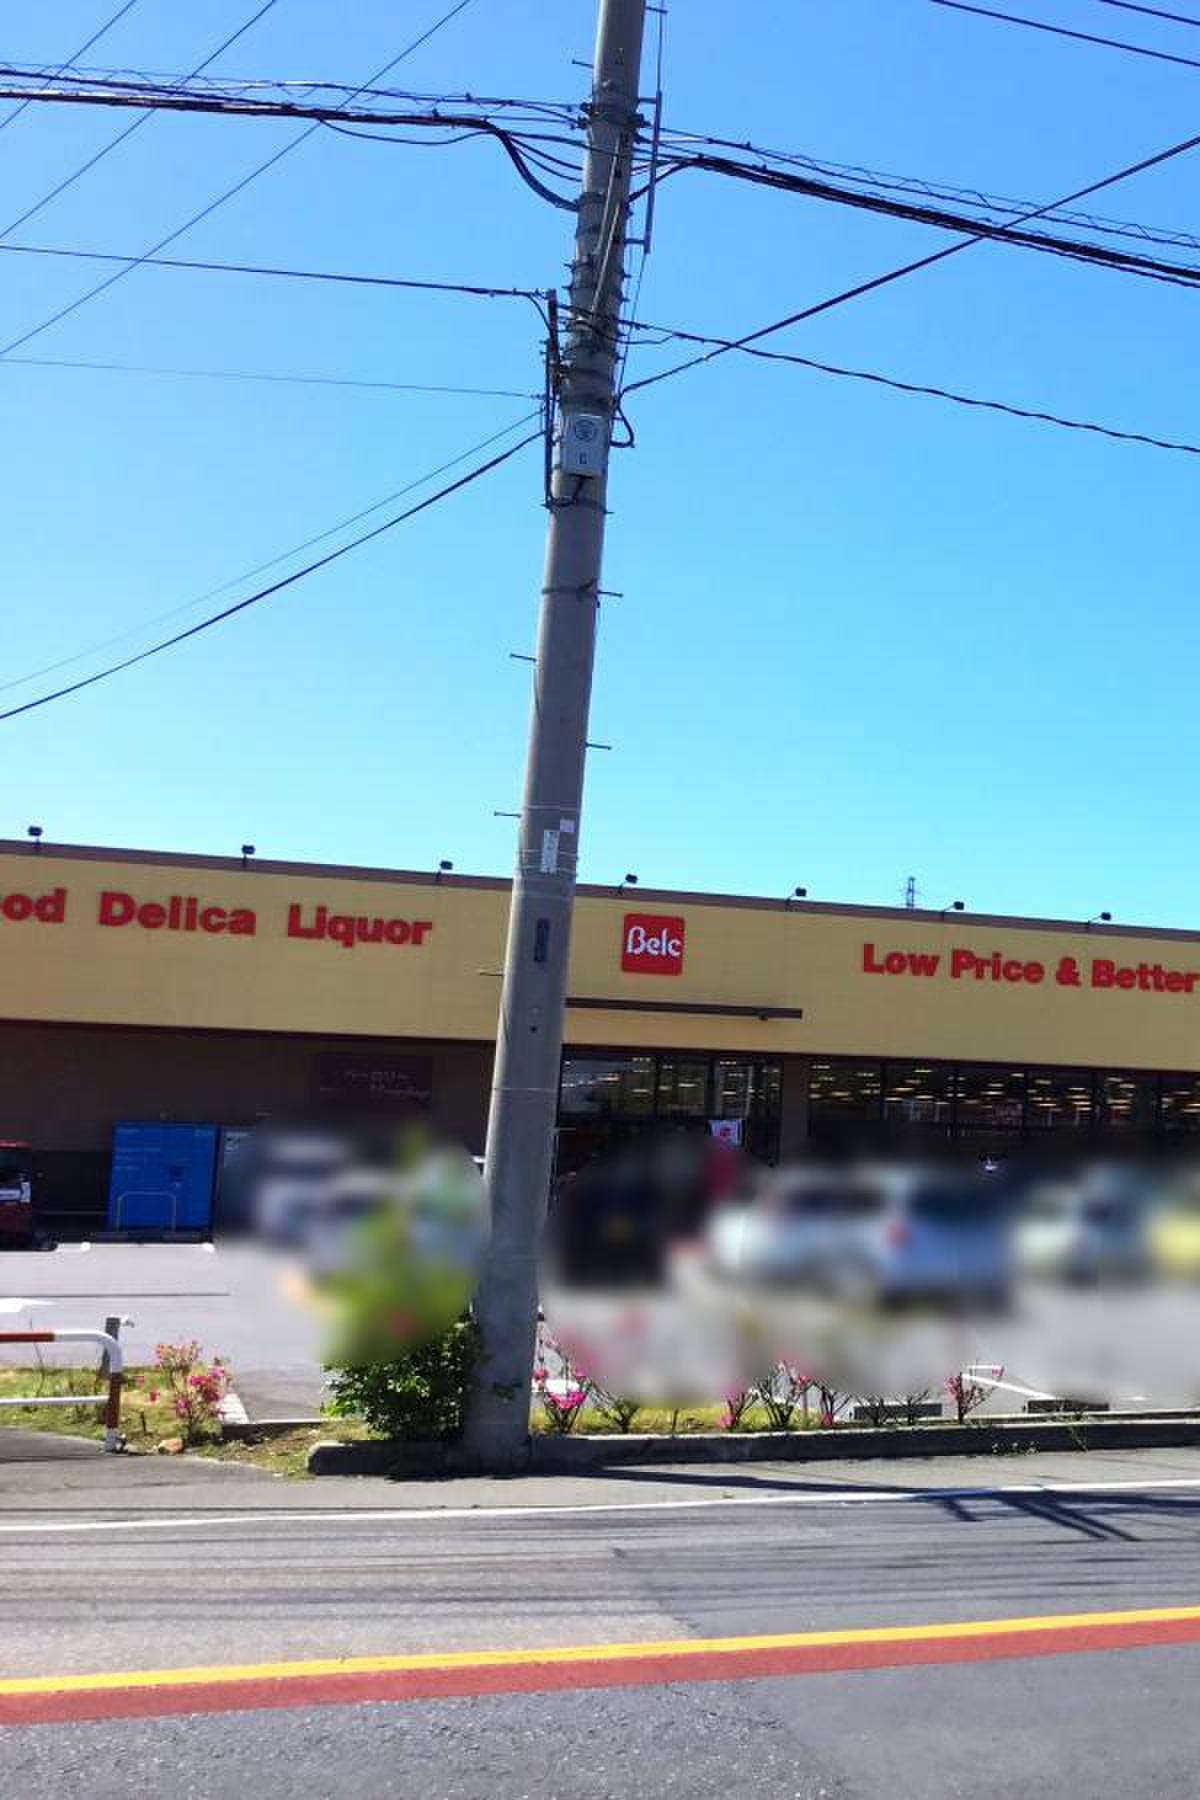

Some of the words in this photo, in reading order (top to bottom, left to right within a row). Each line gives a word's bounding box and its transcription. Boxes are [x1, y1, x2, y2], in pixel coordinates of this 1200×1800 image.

[98, 890, 257, 935] Delica
[287, 903, 433, 948] Liquor
[626, 925, 682, 957] Belc
[863, 943, 941, 977] Low
[951, 948, 1045, 984] Price
[1055, 956, 1083, 987] &
[1091, 959, 1200, 993] Better
